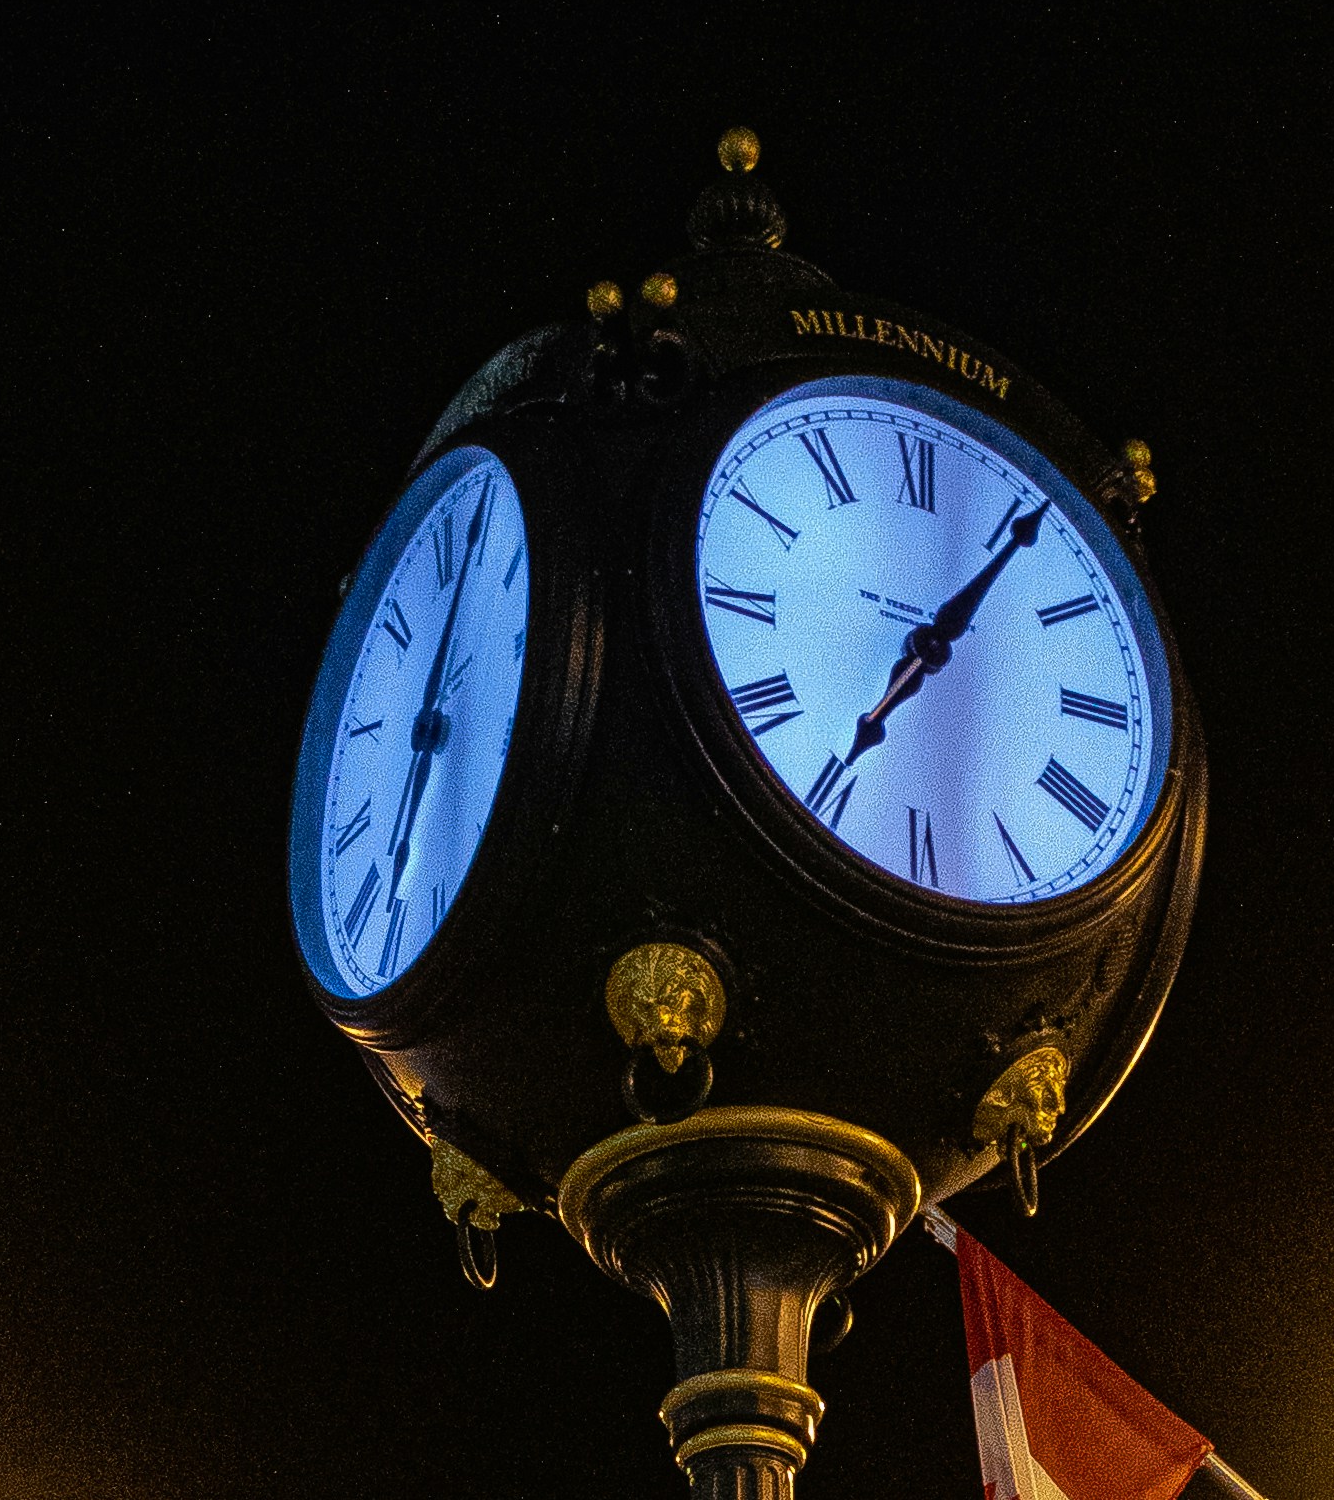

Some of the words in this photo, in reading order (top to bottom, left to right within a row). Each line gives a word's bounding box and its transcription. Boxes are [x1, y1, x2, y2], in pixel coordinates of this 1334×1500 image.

[789, 309, 1013, 400] MILLENNIUM
[897, 432, 939, 514] XII
[1061, 687, 1129, 730] III
